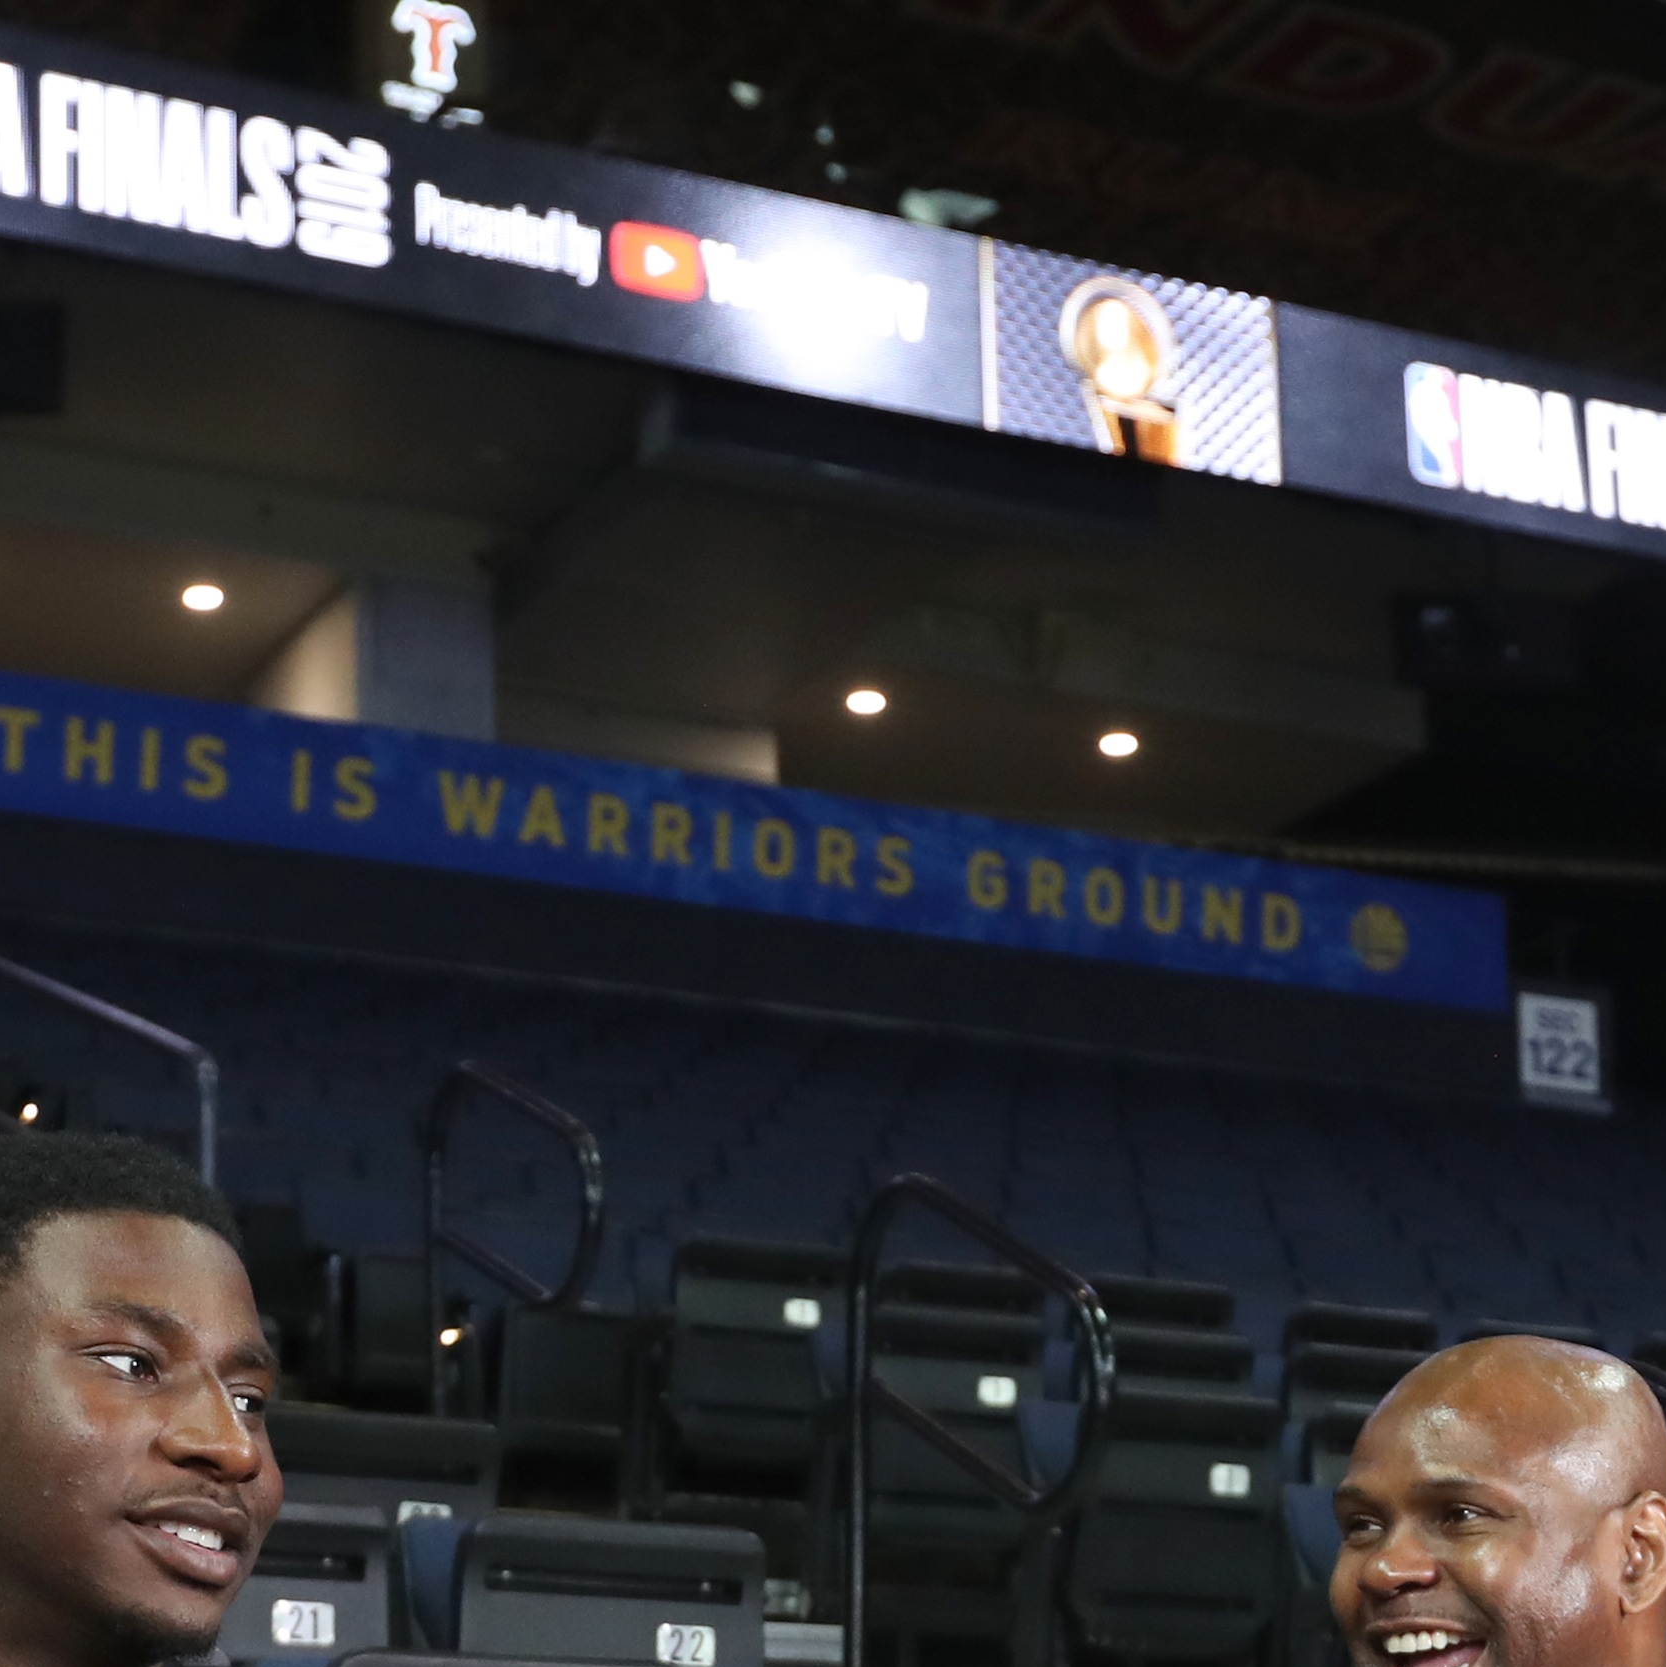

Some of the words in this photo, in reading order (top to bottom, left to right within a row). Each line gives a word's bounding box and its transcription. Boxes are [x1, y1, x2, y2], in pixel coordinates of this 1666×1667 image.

[39, 70, 295, 249] FINALS
[295, 125, 395, 268] 2019
[1458, 373, 1587, 512] NBA
[289, 748, 378, 821] IS
[438, 769, 914, 896] WARRIORS
[966, 850, 1302, 954] GROUND
[1527, 1038, 1595, 1081] 122
[289, 1605, 321, 1640] 21
[669, 1629, 704, 1662] 22
